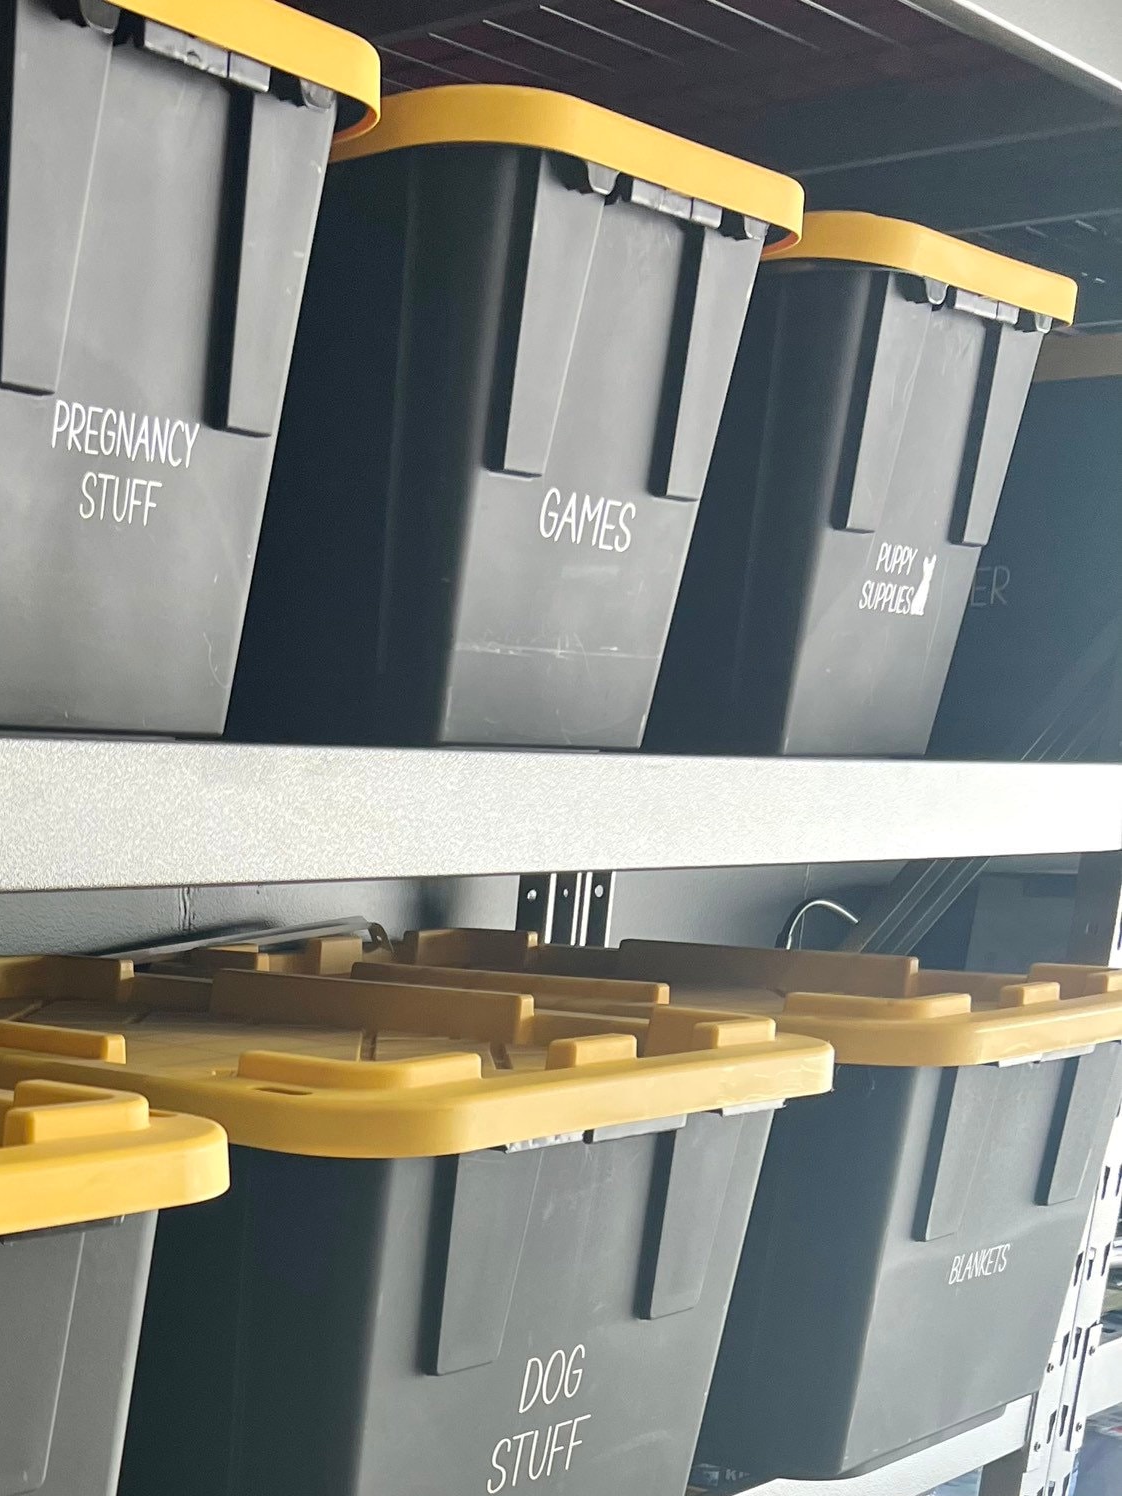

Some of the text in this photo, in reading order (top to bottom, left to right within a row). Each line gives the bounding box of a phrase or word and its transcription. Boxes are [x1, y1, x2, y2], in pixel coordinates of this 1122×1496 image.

[51, 399, 200, 469] PREGNANCY
[79, 471, 163, 527] STUFF
[539, 487, 636, 553] GAMES
[875, 541, 919, 576] PUPPY
[858, 579, 915, 615] SUPPLIES
[948, 1243, 1011, 1285] BLANKETS
[518, 1343, 586, 1414] DOG
[486, 1413, 592, 1494] STUFF
